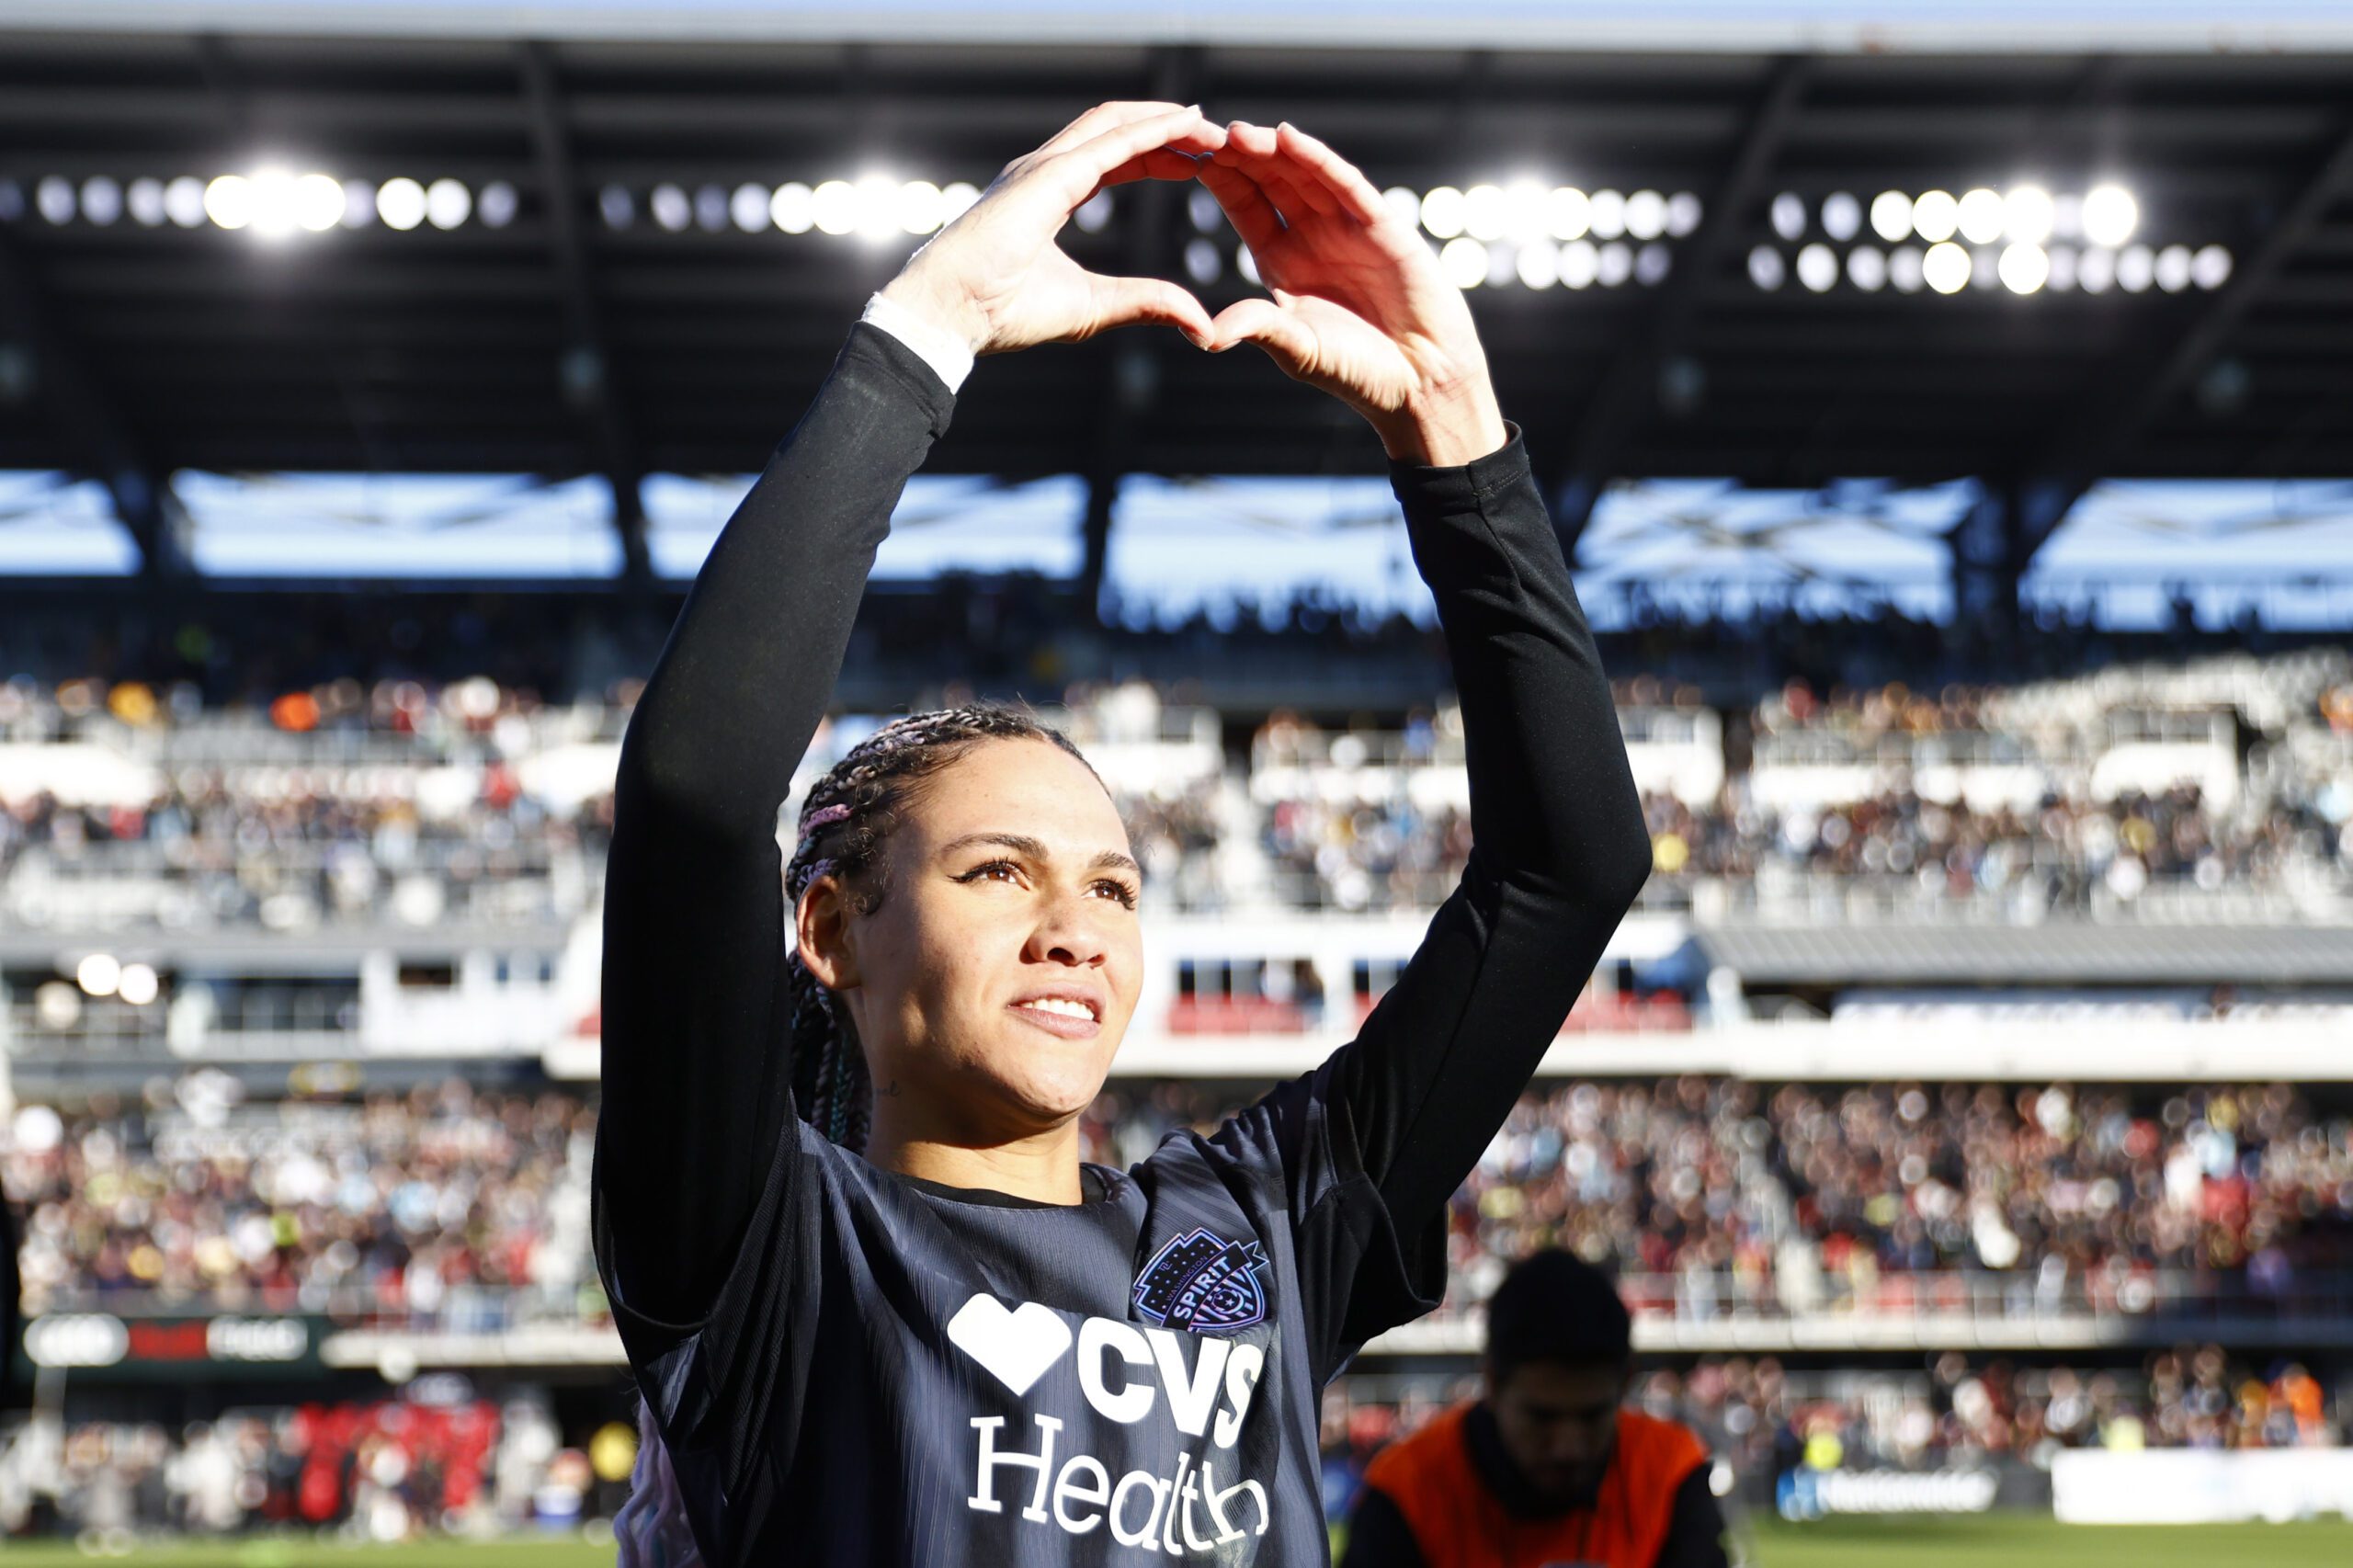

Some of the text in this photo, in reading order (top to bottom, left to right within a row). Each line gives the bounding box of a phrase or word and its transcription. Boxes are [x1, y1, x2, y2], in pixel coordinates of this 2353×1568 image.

[1165, 1256, 1208, 1301] WASHINGTON
[1173, 1256, 1231, 1320] SPIRIT
[1077, 1316, 1264, 1449] CVS
[967, 1413, 1269, 1555] Health
